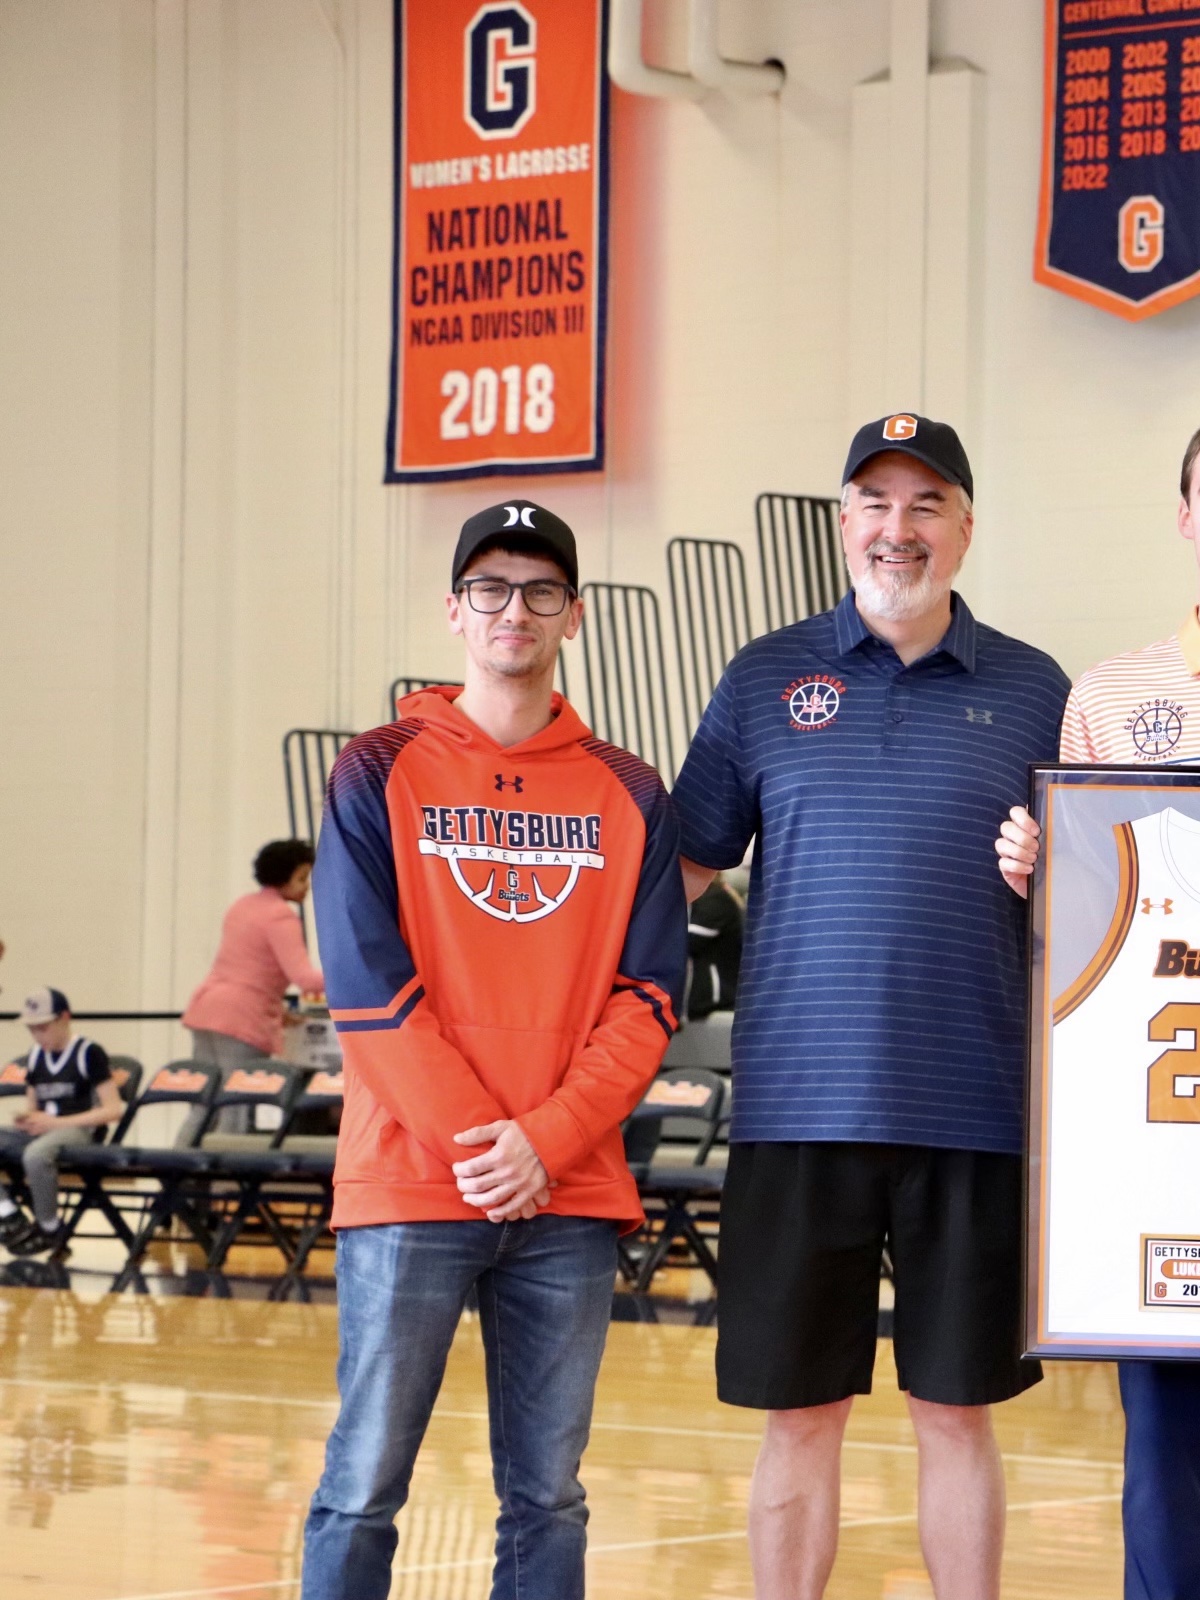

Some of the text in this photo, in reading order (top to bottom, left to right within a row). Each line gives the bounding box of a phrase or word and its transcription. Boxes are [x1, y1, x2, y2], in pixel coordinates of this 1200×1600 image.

[464, 1, 537, 140] G
[1065, 46, 1111, 76] 2000
[1122, 40, 1168, 69] 2002
[1064, 75, 1110, 104] 2004
[1122, 70, 1166, 99] 2005
[1063, 105, 1110, 133] 2012
[1121, 100, 1167, 128] 2013
[1063, 134, 1110, 161] 2016
[1120, 129, 1166, 158] 2018
[411, 144, 590, 189] WOMEN'S LACROSSE
[1062, 163, 1109, 191] 2022
[427, 198, 568, 253] NATIONAL
[1118, 194, 1164, 273] G
[411, 250, 586, 307] CHAMPIONS
[410, 304, 585, 347] NCAA DIVISION III
[440, 364, 555, 440] 2018
[883, 414, 918, 441] G
[781, 674, 847, 701] GETTYSBURG
[1124, 699, 1188, 731] GETTYSBURG
[421, 805, 601, 851] GETTYSBURG
[436, 845, 592, 865] BASKETBALL
[498, 888, 530, 902] Bullets
[1154, 1282, 1167, 1298] G
